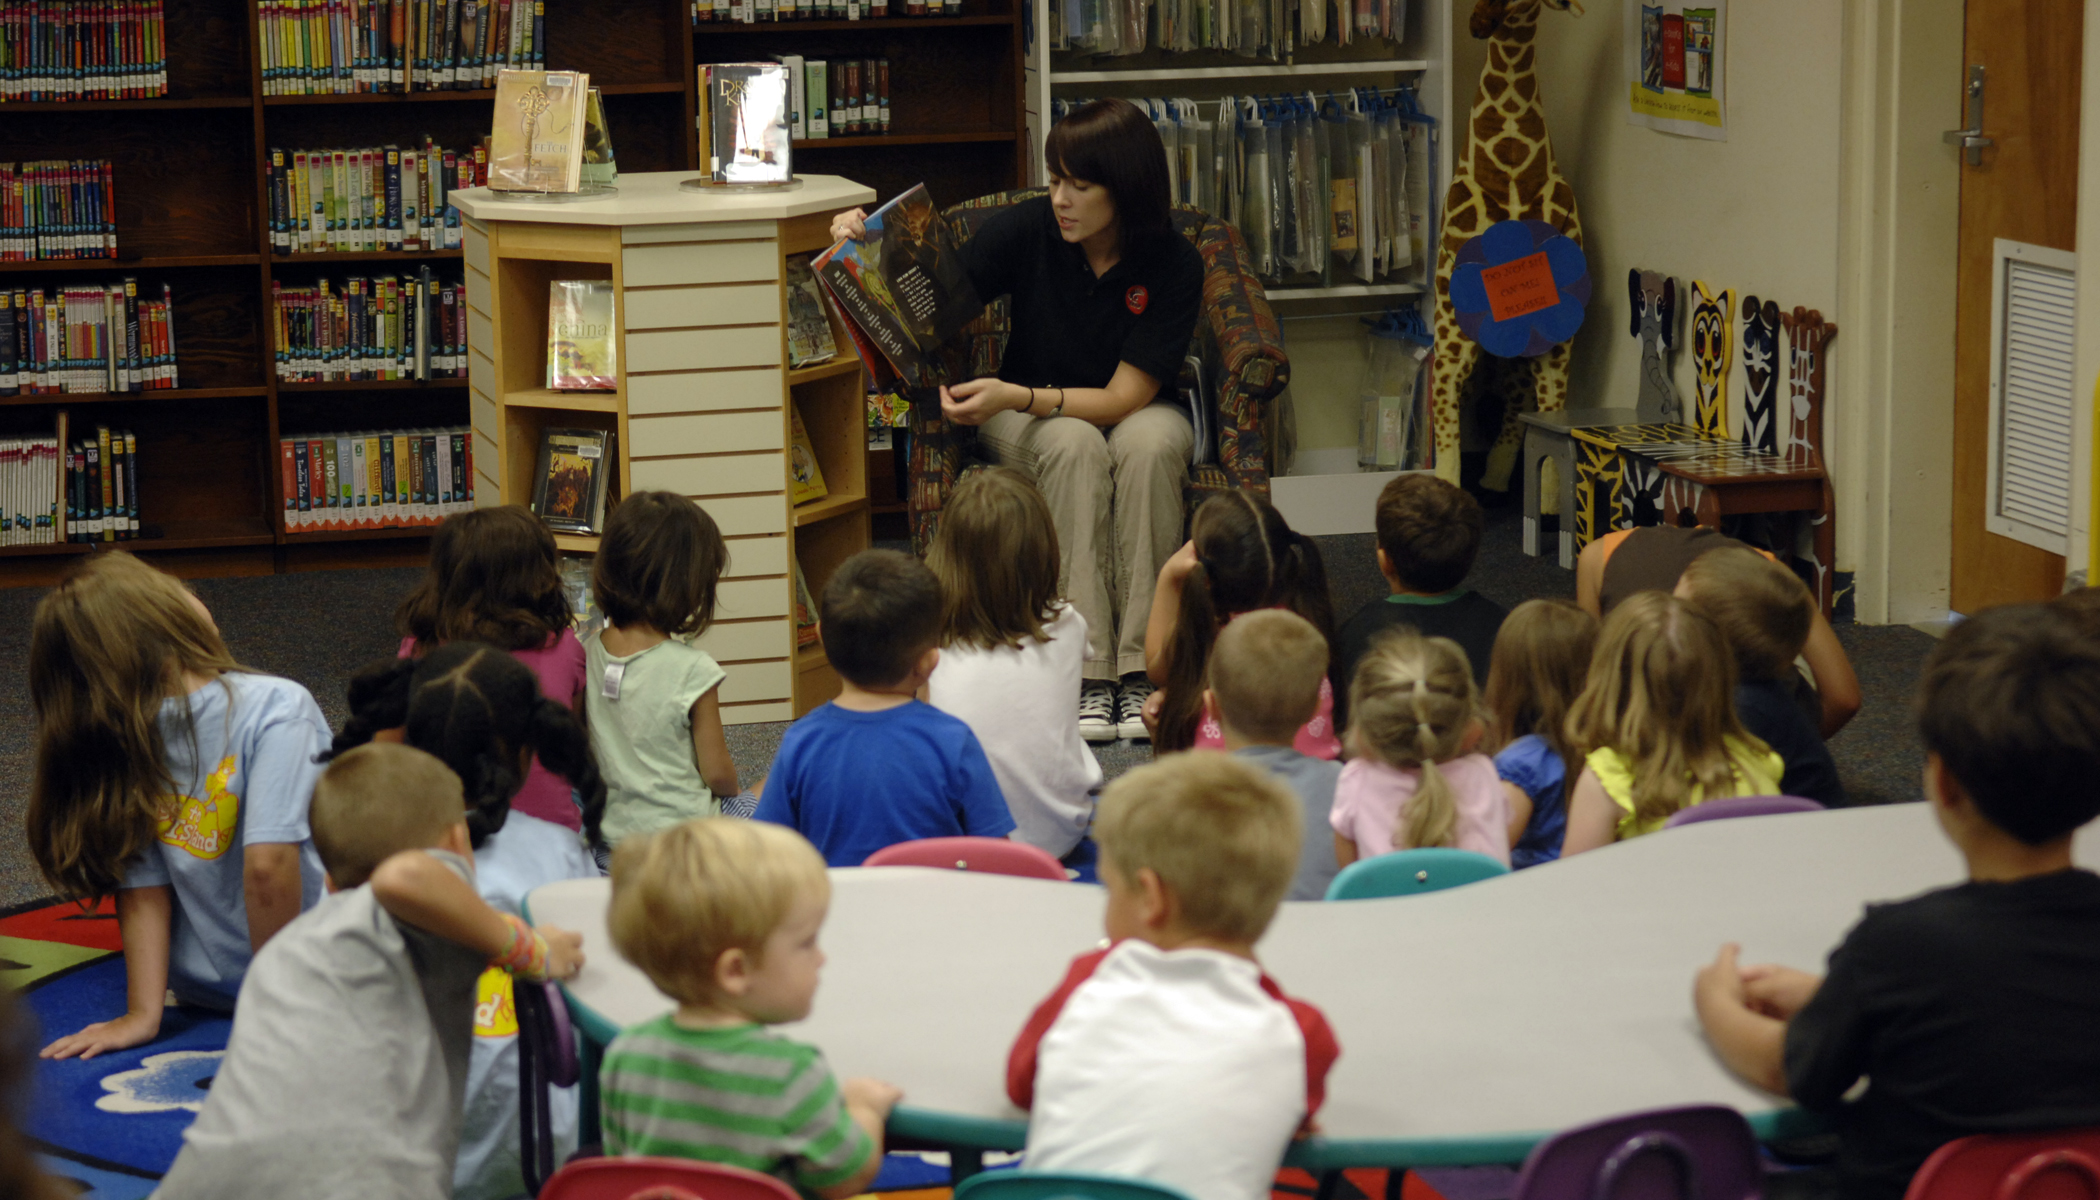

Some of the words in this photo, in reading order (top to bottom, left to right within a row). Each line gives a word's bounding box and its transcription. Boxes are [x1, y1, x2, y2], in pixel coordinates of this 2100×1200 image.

[534, 144, 568, 153] FETCH
[1503, 261, 1526, 277] NOT
[314, 458, 322, 480] Marley
[326, 460, 336, 477] 100
[189, 804, 202, 822] to
[165, 818, 219, 852] Island
